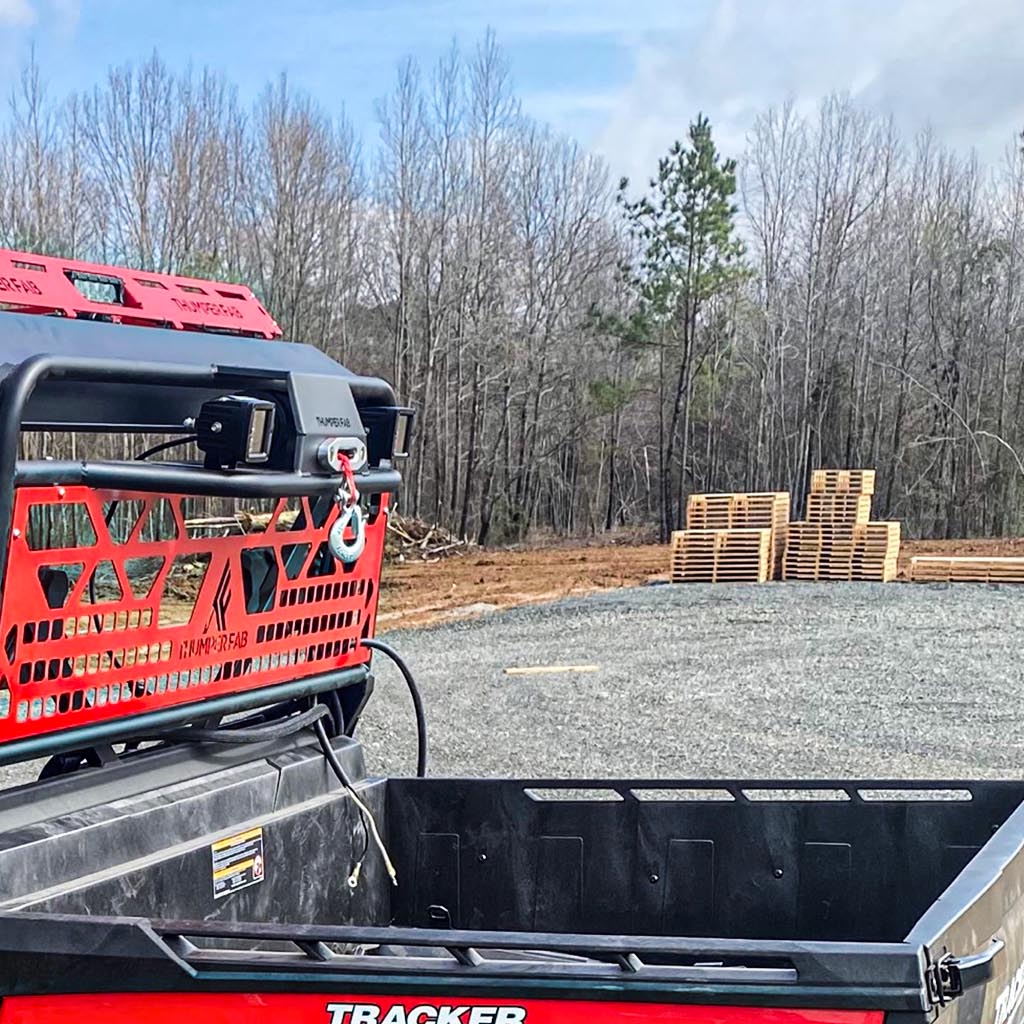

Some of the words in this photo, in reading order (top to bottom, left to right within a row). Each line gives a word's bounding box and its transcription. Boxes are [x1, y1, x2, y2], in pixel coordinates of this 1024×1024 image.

[10, 277, 43, 295] FAB
[179, 634, 228, 660] THUMPER
[228, 630, 249, 650] FAB
